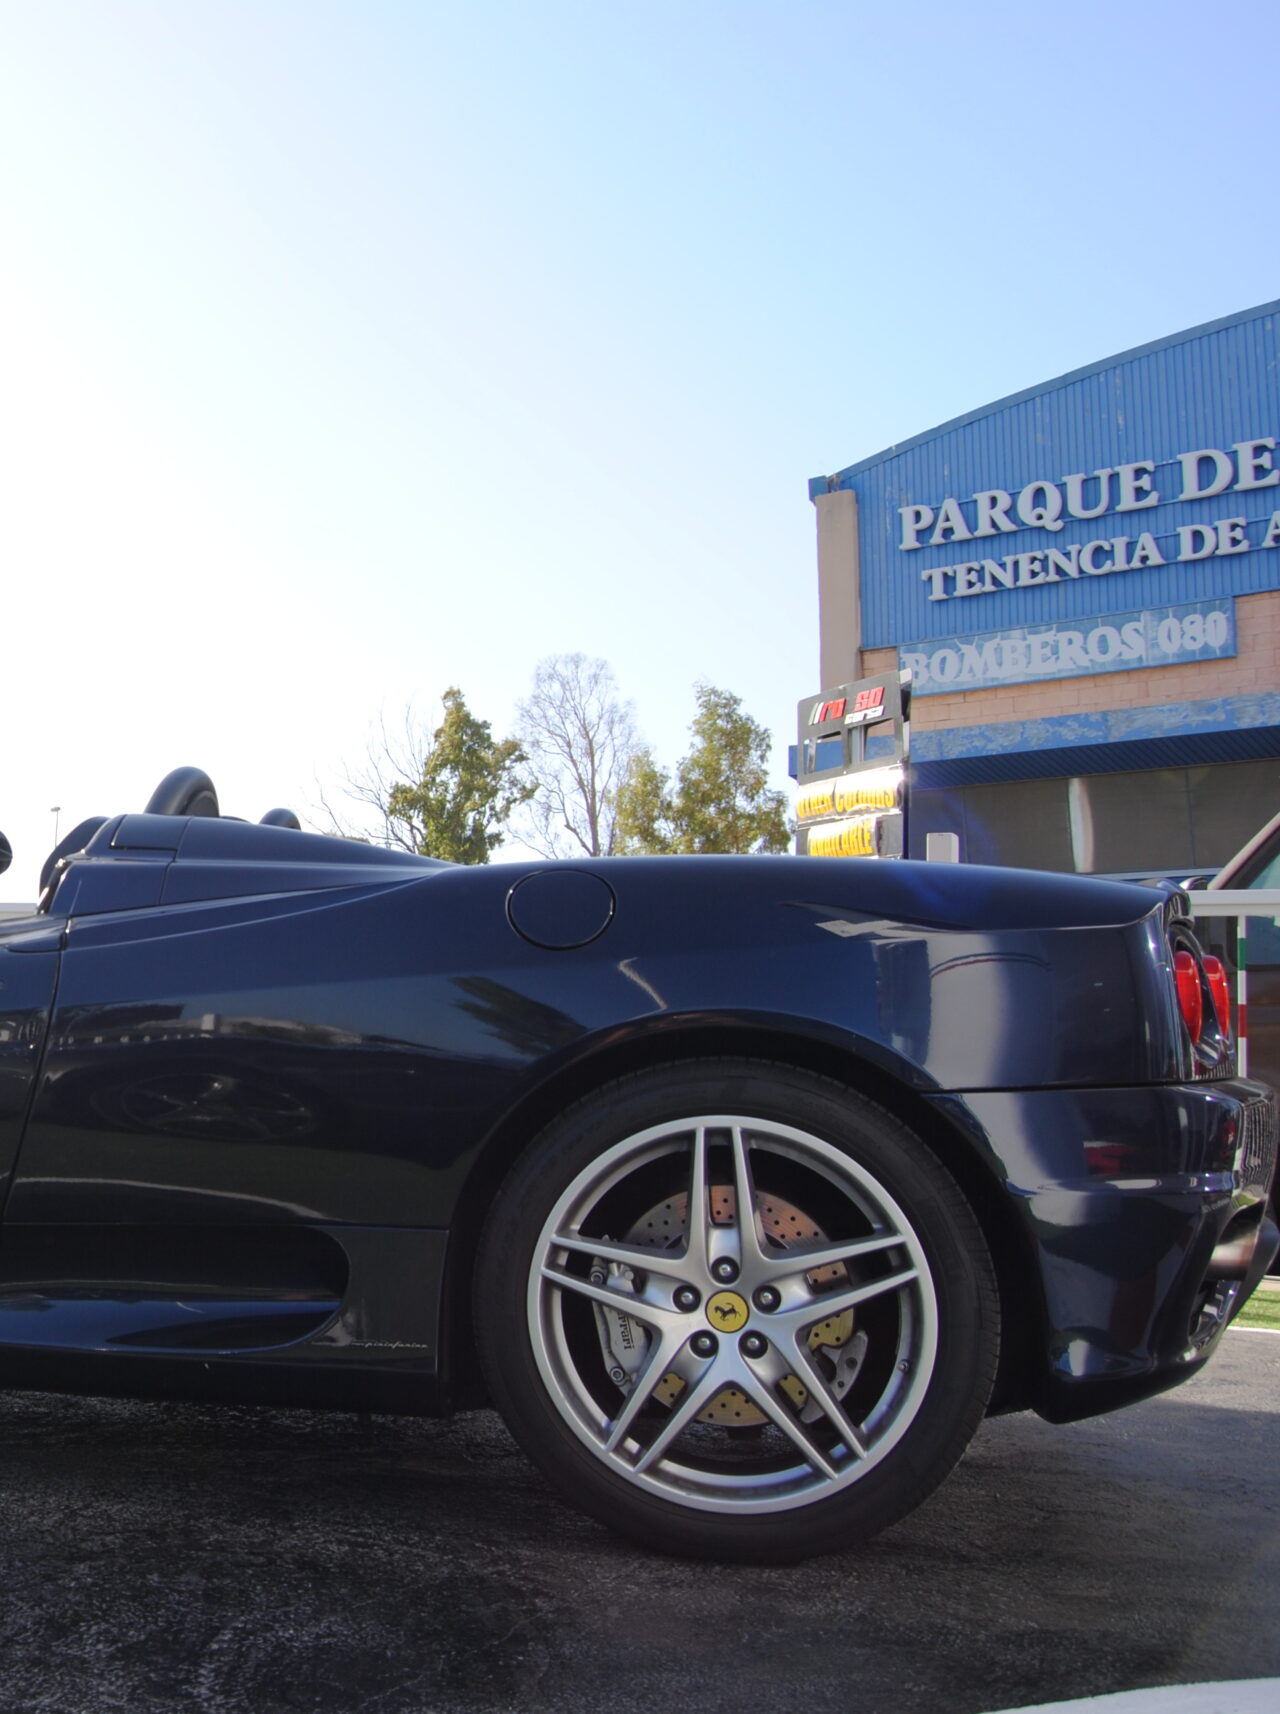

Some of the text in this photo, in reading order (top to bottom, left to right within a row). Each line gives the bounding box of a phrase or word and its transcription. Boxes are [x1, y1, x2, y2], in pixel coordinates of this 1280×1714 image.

[898, 436, 1280, 551] PARQUE DE
[922, 531, 1167, 602] TENENCIA
[1176, 516, 1251, 563] DE
[901, 610, 1229, 684] BOMBEROS 080
